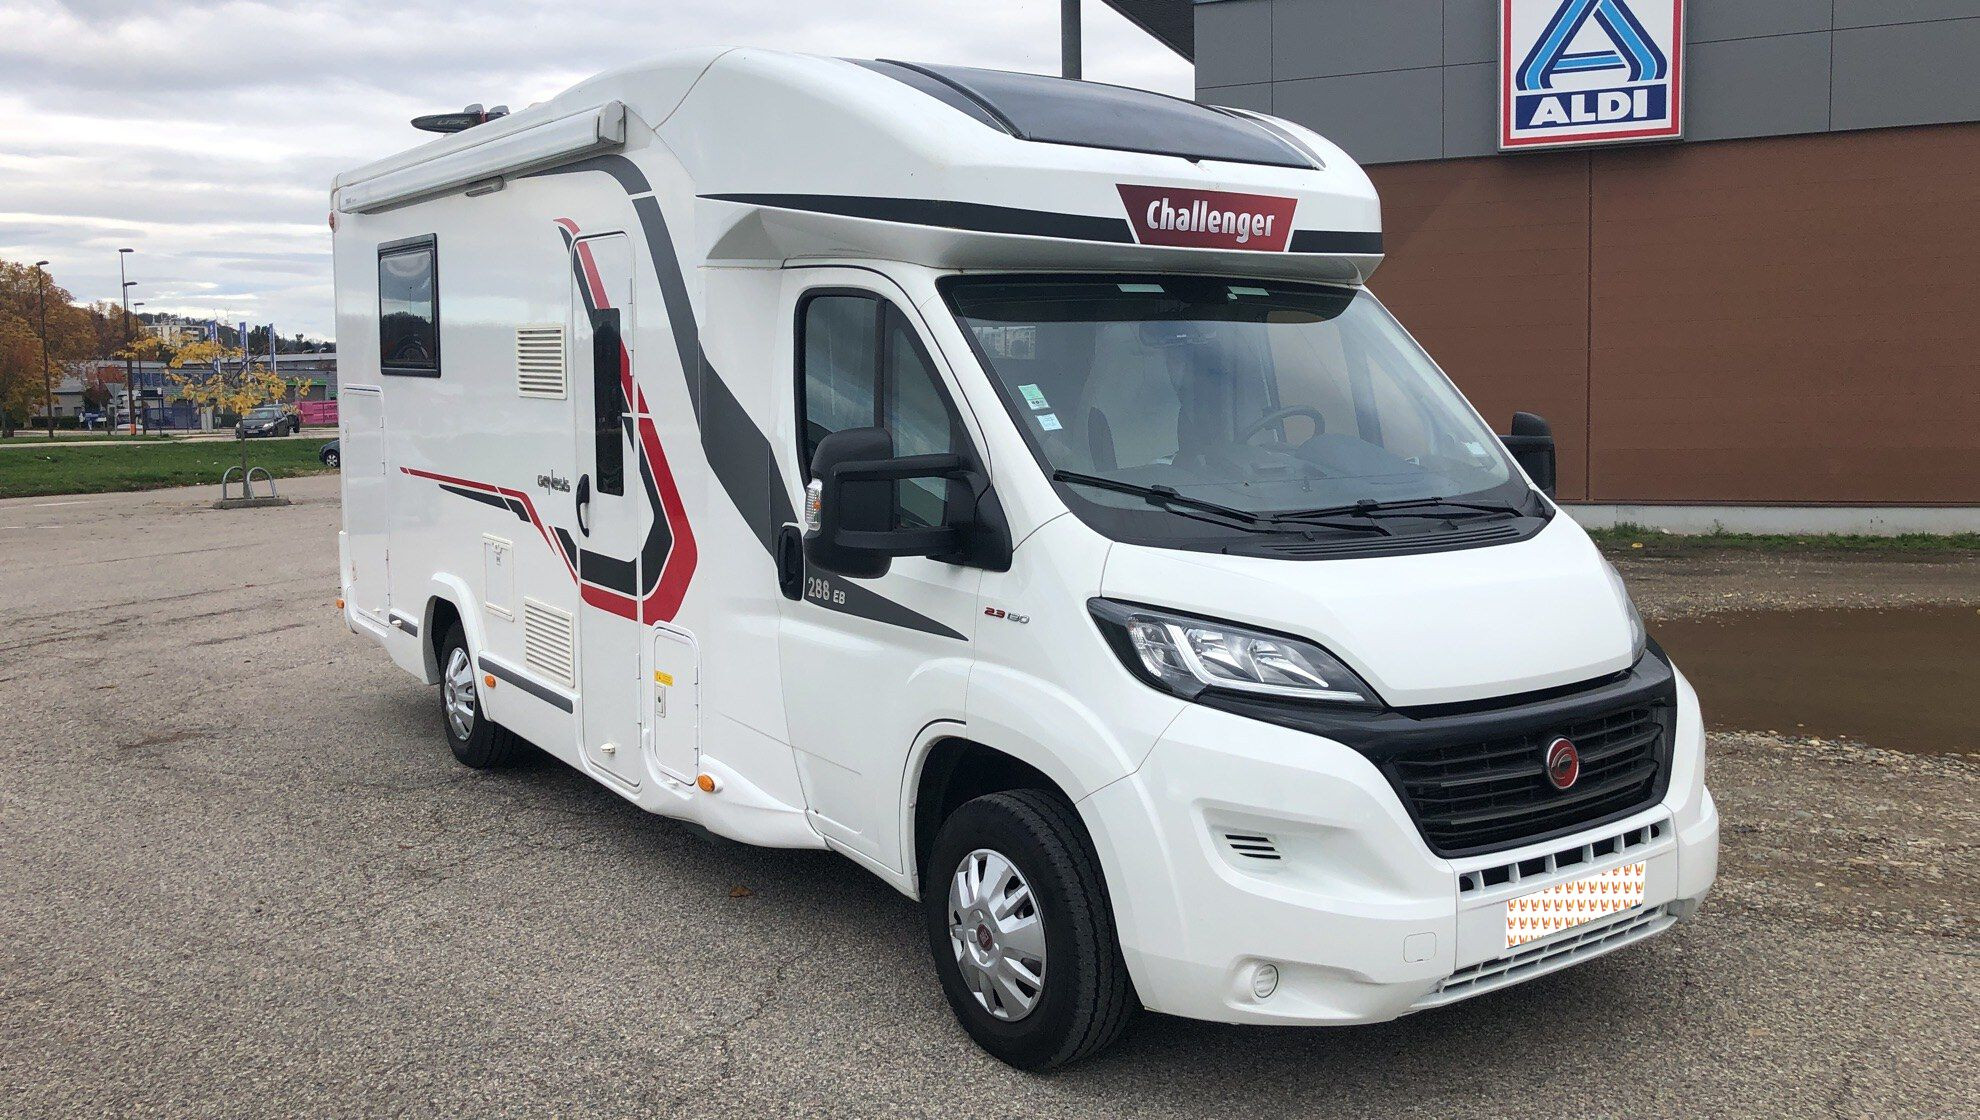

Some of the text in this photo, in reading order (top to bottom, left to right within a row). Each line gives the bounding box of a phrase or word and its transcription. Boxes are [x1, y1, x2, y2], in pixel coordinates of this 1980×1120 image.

[1528, 89, 1648, 127] ALDI
[1146, 197, 1275, 244] Challenger
[808, 576, 846, 605] 288 EB
